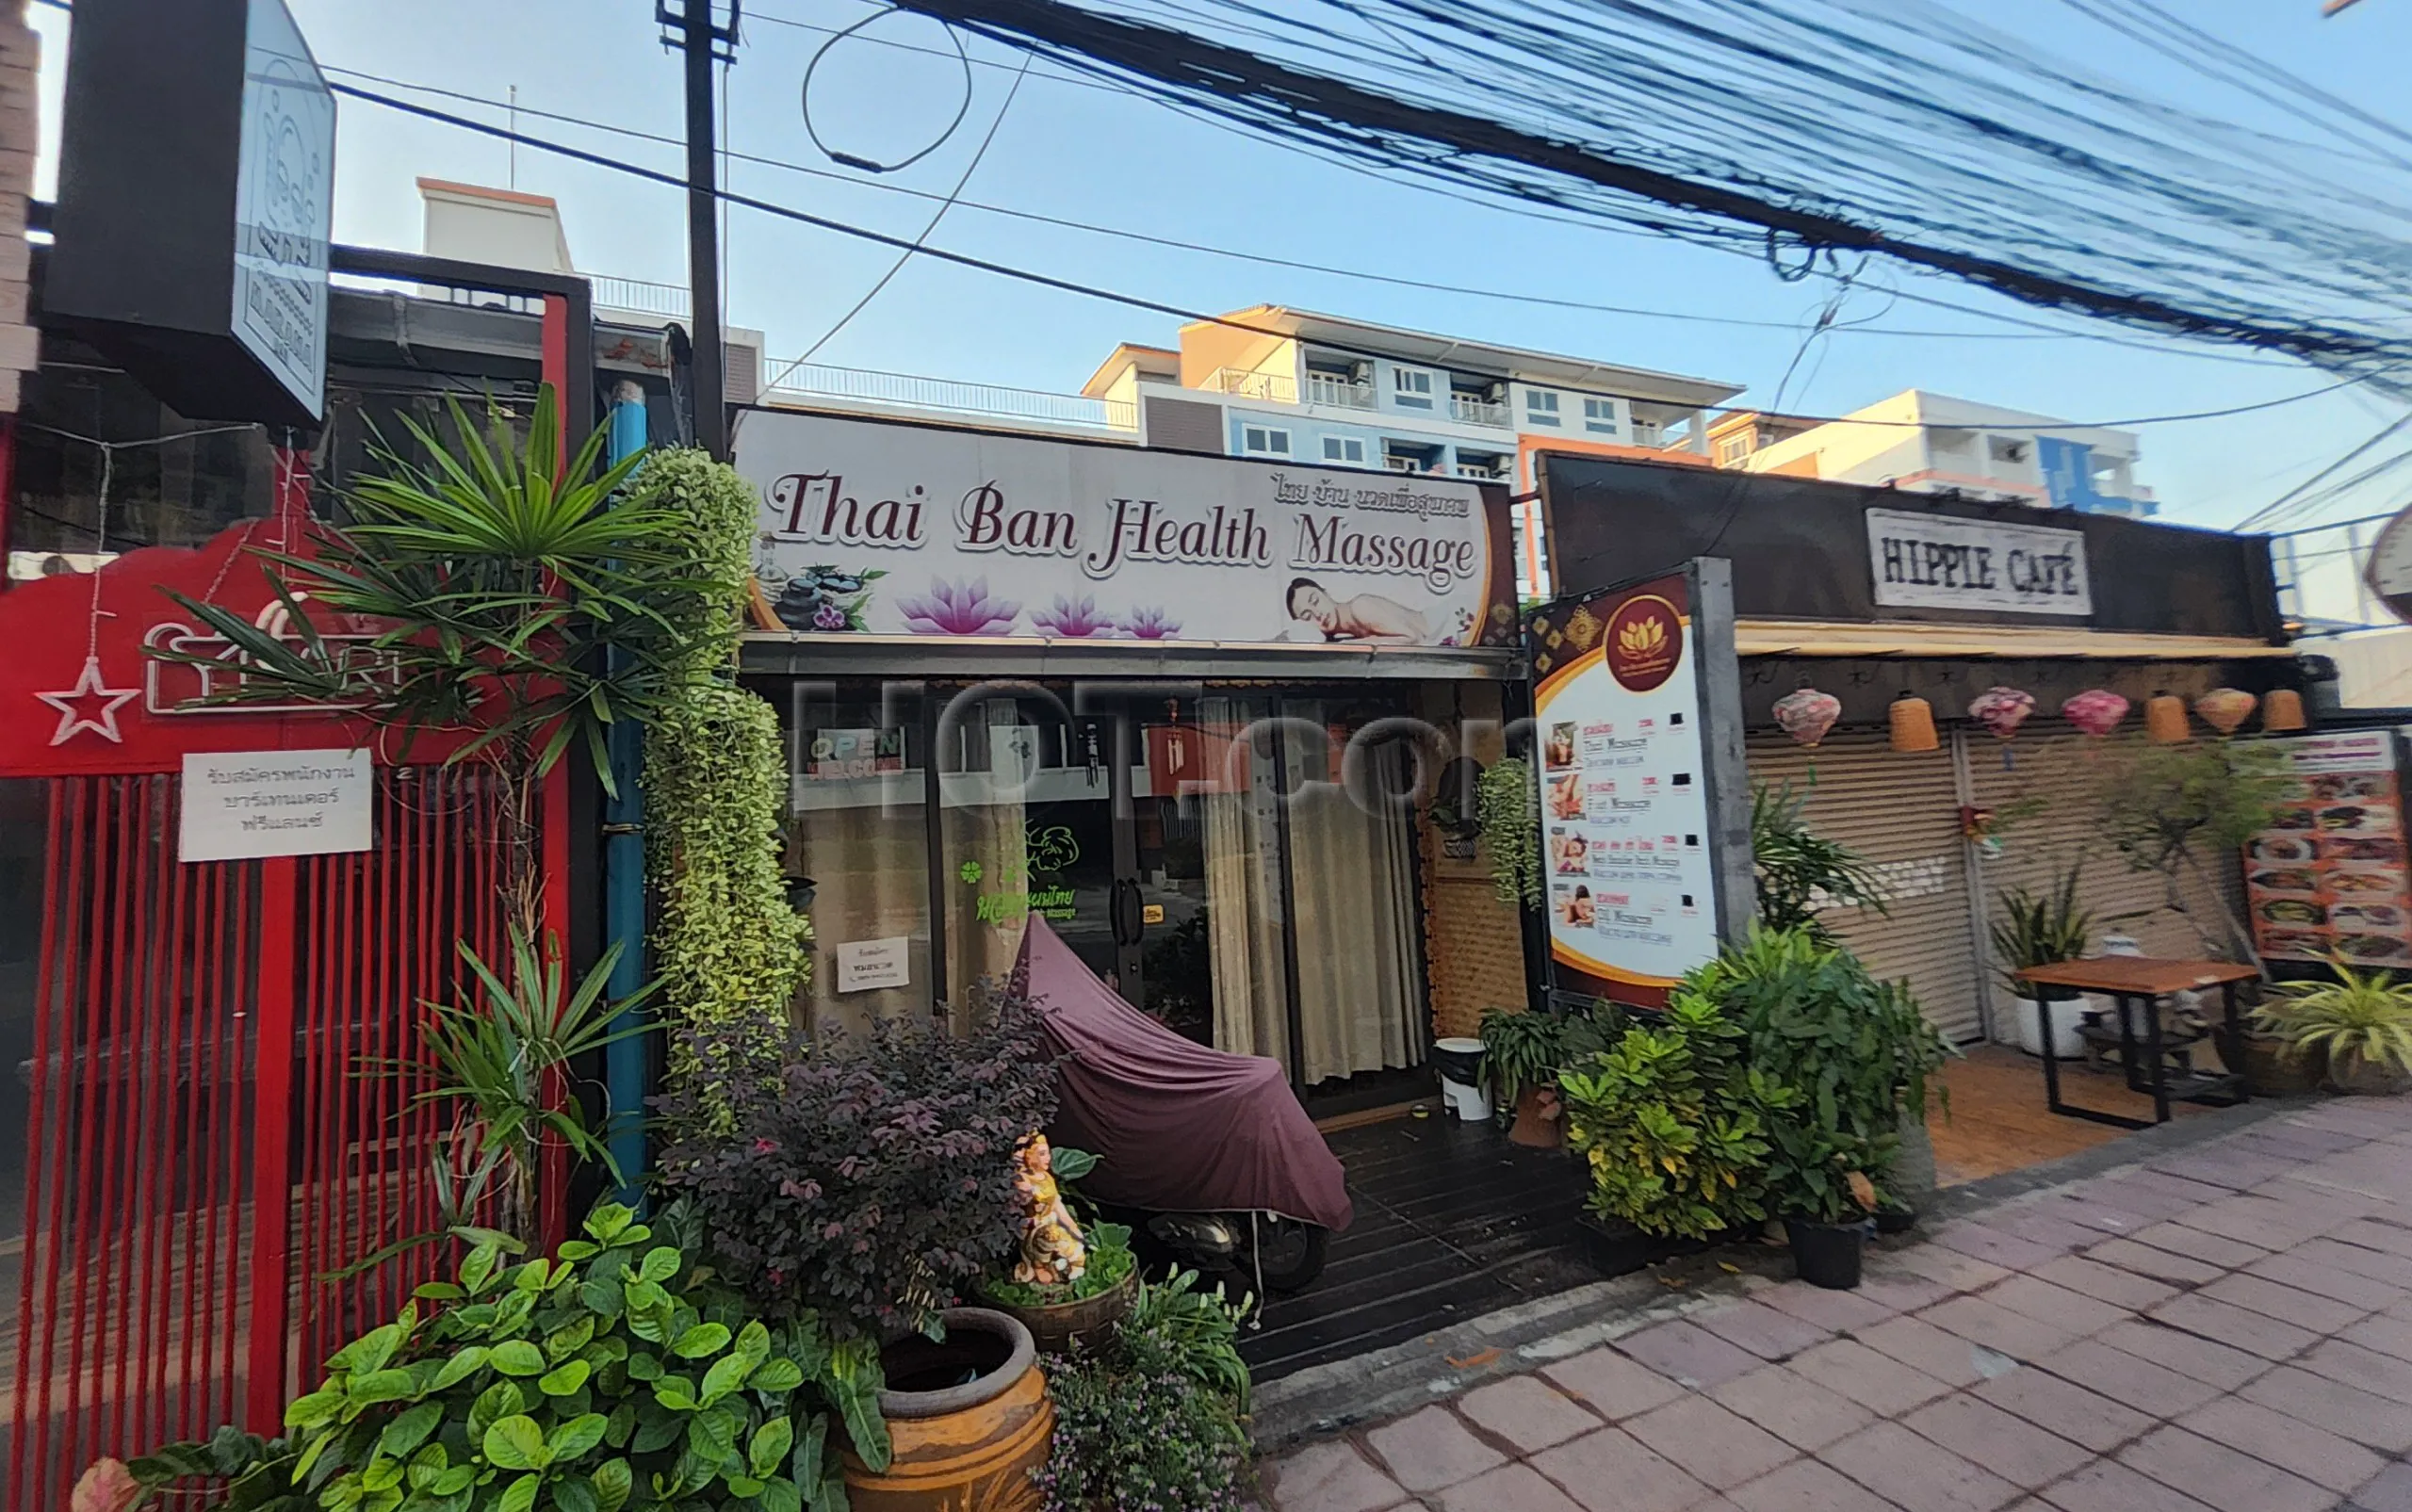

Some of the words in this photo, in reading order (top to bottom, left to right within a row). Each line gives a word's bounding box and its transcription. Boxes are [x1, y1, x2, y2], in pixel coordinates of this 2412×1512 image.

[1270, 473, 1309, 504] ไทย
[1312, 479, 1350, 509] บ้าน
[771, 469, 926, 544] Thai
[959, 479, 1078, 549] Ban
[1087, 497, 1271, 573] Health
[1292, 512, 1475, 588] Massage
[1882, 537, 1996, 590] HIPPIE
[810, 735, 900, 759] OPEN
